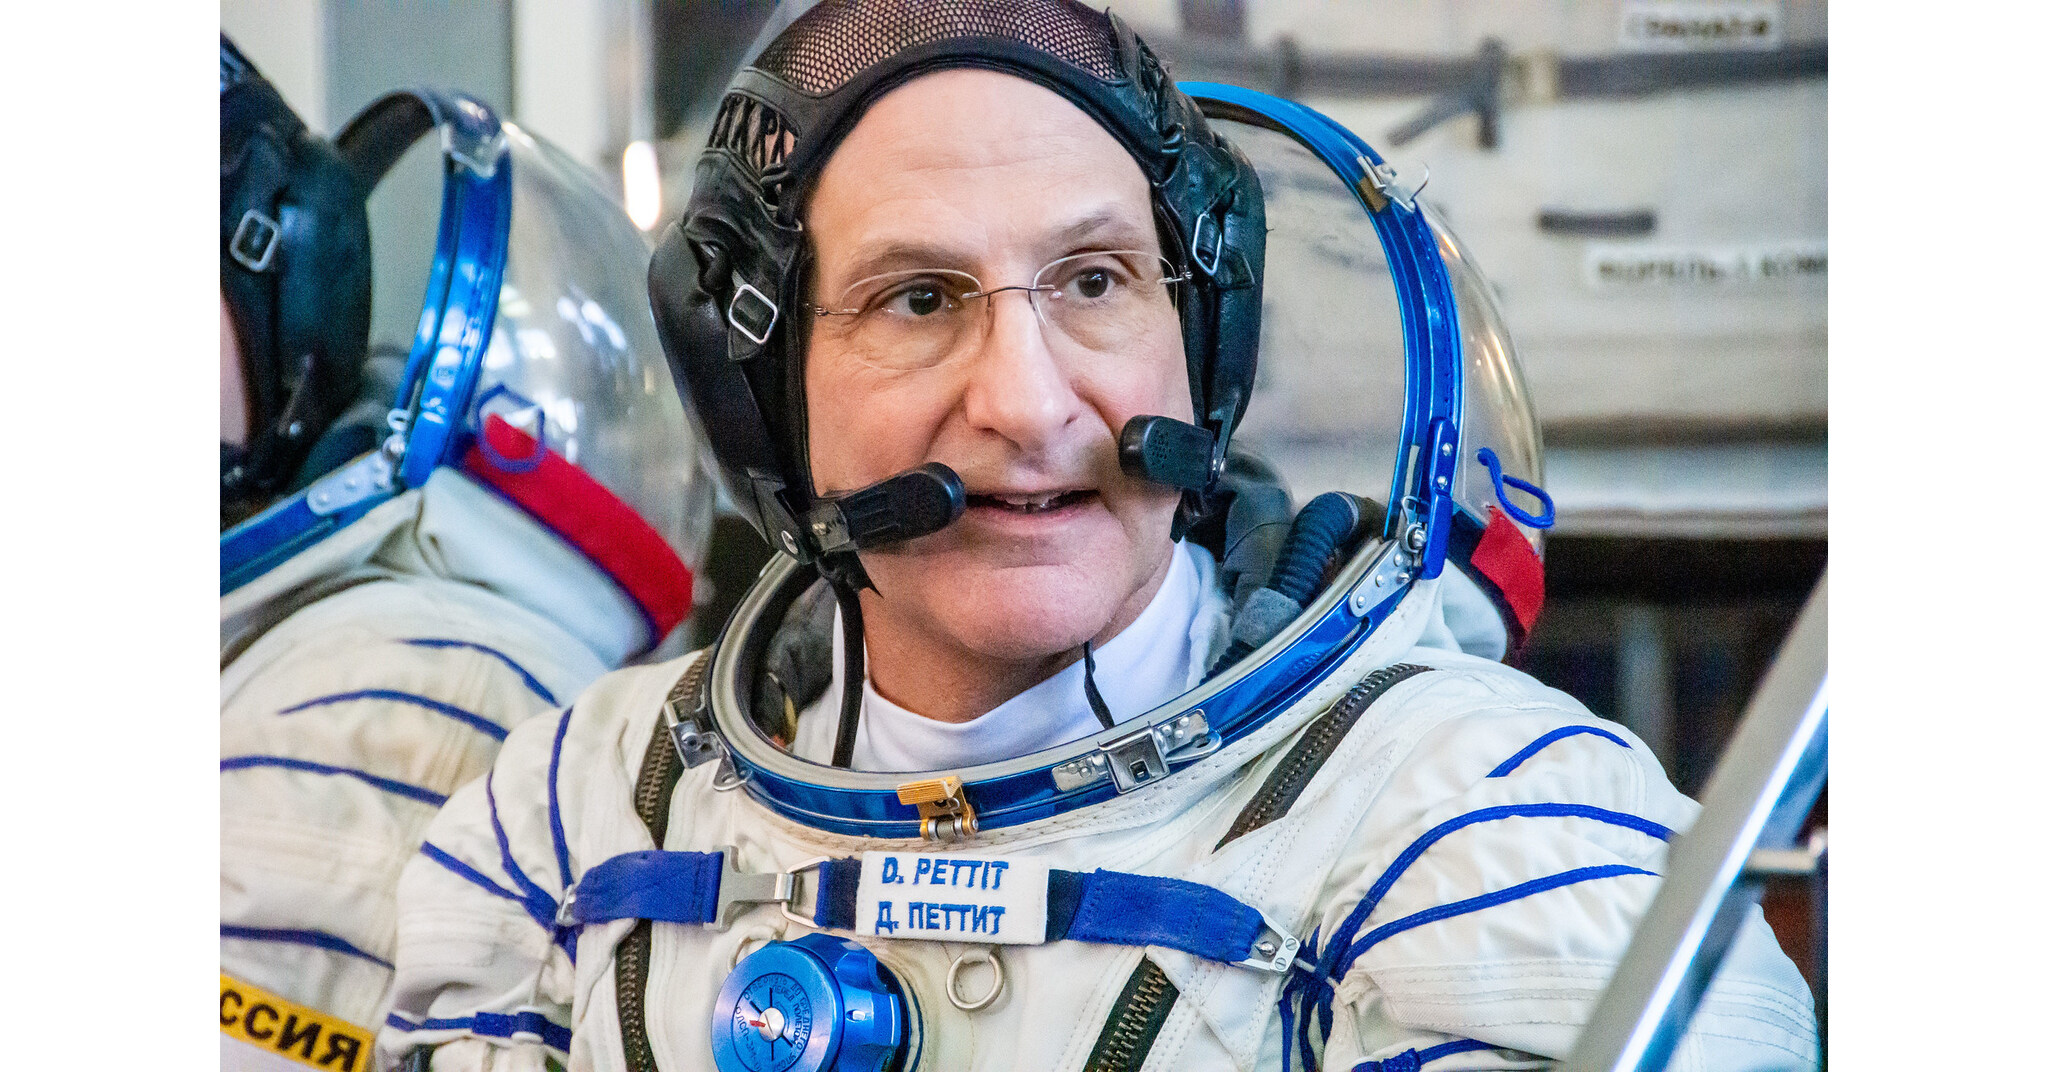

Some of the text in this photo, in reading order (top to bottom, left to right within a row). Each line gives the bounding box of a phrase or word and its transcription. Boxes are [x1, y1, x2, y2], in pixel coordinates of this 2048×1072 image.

[882, 857, 1009, 890] D. PETTIT
[875, 901, 1006, 935] Д. ПЕТТИТ
